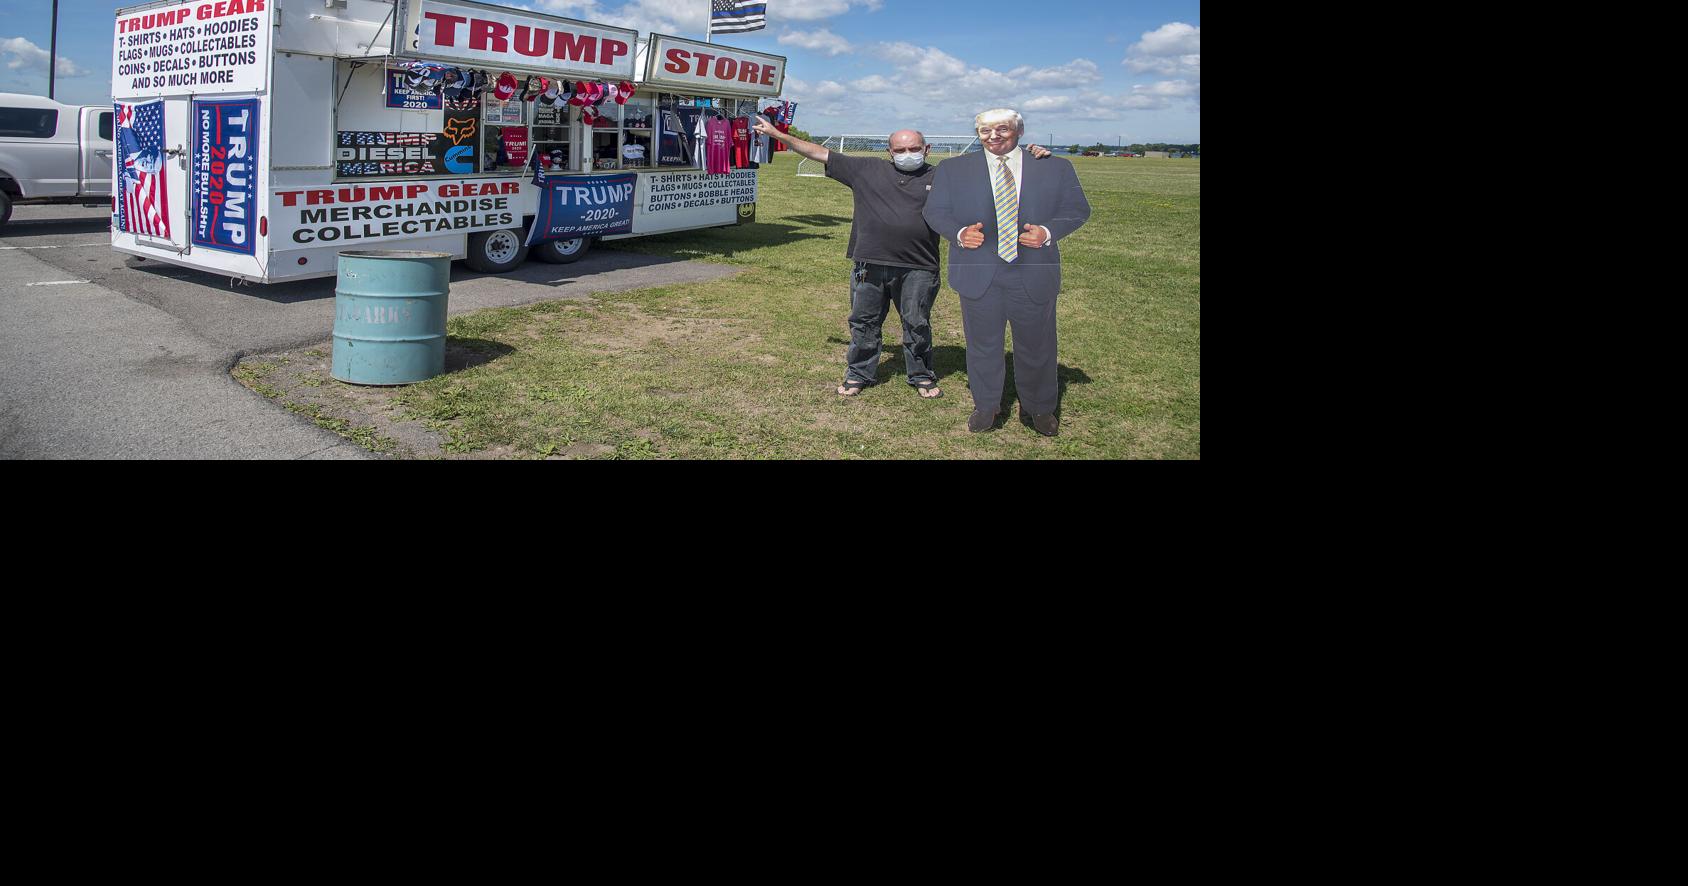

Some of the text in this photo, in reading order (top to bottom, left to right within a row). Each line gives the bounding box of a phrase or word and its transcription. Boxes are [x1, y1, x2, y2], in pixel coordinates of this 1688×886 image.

[118, 0, 265, 33] TRUMP GEAR
[128, 31, 161, 47] SHIRTS
[170, 26, 195, 41] HATS
[204, 17, 259, 36] HOODIES
[424, 11, 628, 65] TRUMP
[119, 34, 256, 62] FLAGS MUGS COLLECTABLES
[119, 51, 256, 76] COINS DECALS BUTTONS
[664, 48, 775, 86] STORE
[132, 70, 234, 89] AND SO MUCH MORE
[403, 101, 428, 109] 2020
[337, 147, 436, 160] DIESEL
[198, 110, 210, 238] NO MORE BULLSHIT
[209, 146, 226, 205] 2020
[222, 109, 249, 244] TRUMP
[651, 179, 755, 193] FLAGS MUGS COLLECTABLES
[660, 174, 692, 183] SHIRTS
[699, 173, 719, 181] HATS
[726, 171, 756, 179] HOODIES
[274, 182, 520, 207] TRUMP GEAR
[556, 183, 633, 205] TRUMP
[648, 195, 754, 212] COINS DECALS BUTTONS
[650, 187, 754, 203] BUTTONS BOBBLE HEADS
[300, 197, 508, 224] MERCHANDISE
[292, 212, 513, 244] COLLECTABLES
[576, 223, 608, 232] AMERICA
